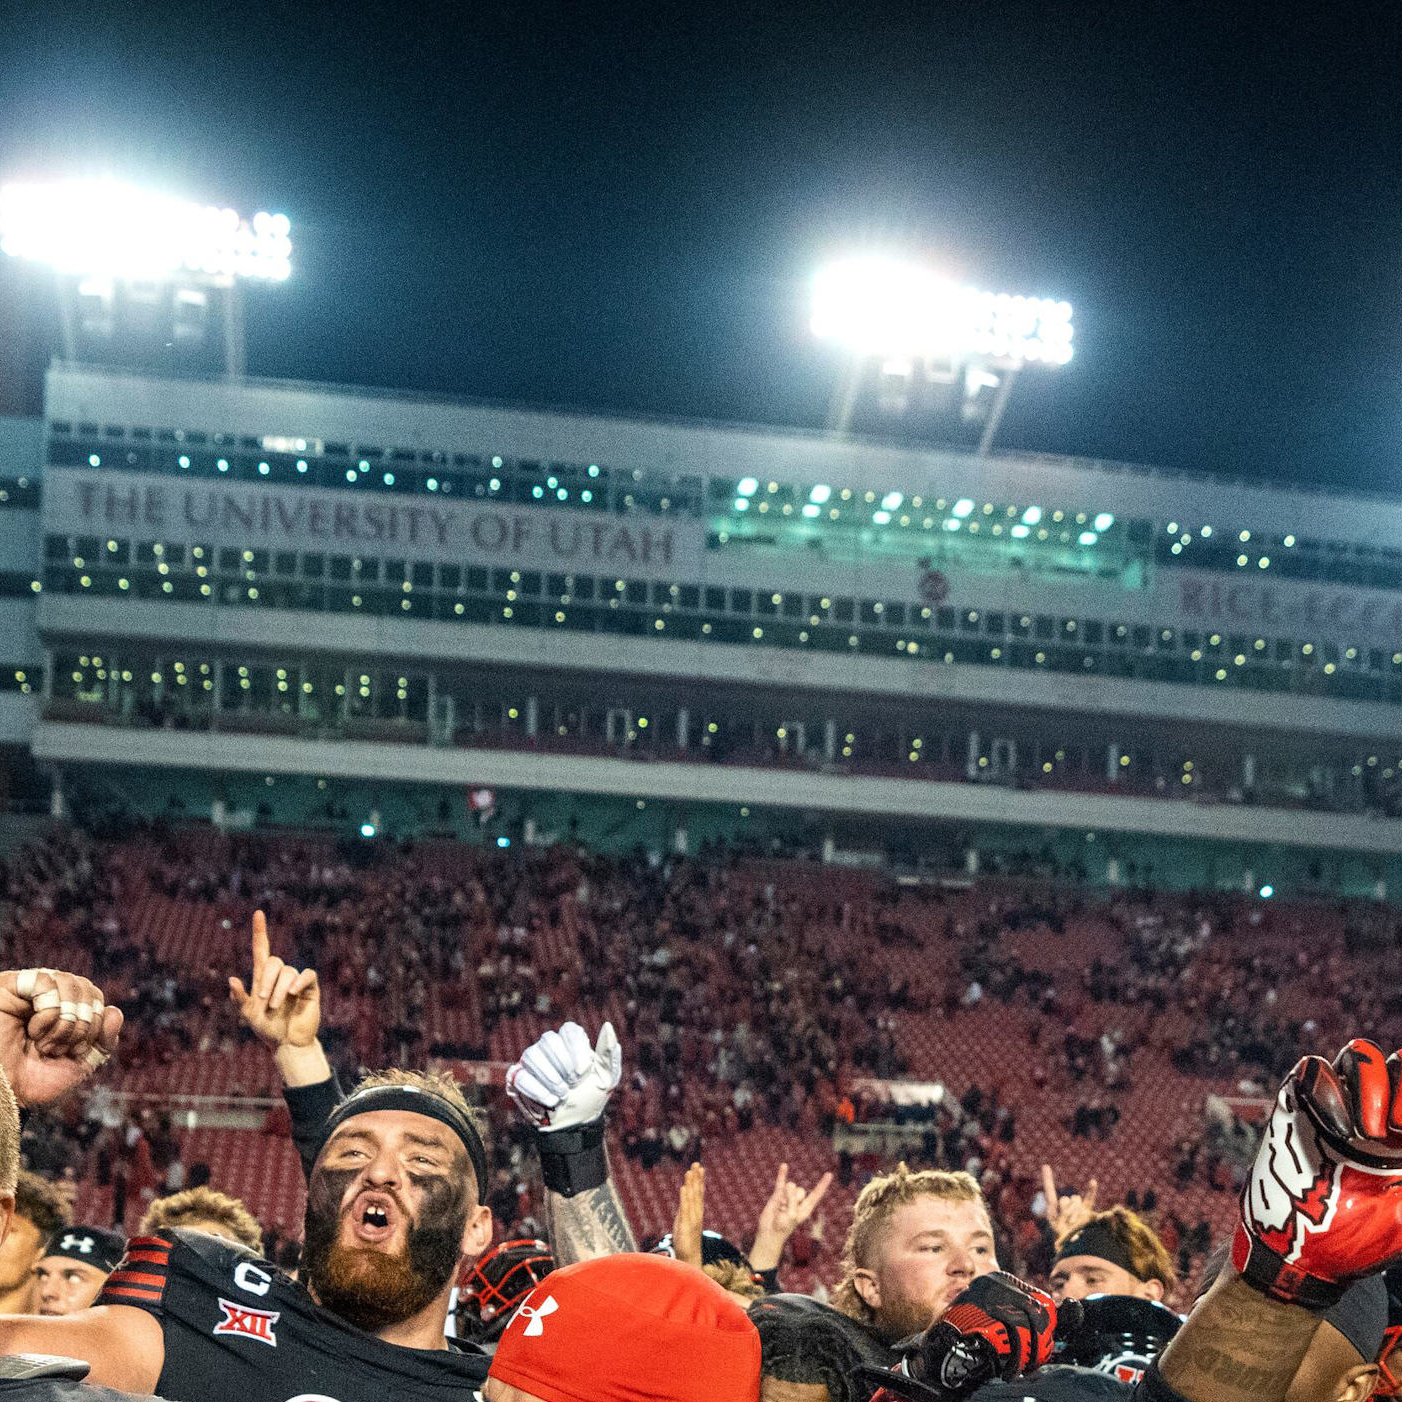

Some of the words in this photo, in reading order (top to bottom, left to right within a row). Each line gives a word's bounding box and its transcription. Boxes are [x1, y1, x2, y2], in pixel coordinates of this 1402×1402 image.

[73, 480, 163, 527] THE
[183, 492, 451, 546] UNIVERSITY
[471, 512, 531, 554] OF
[550, 520, 674, 566] UTAH
[233, 1261, 272, 1297] C
